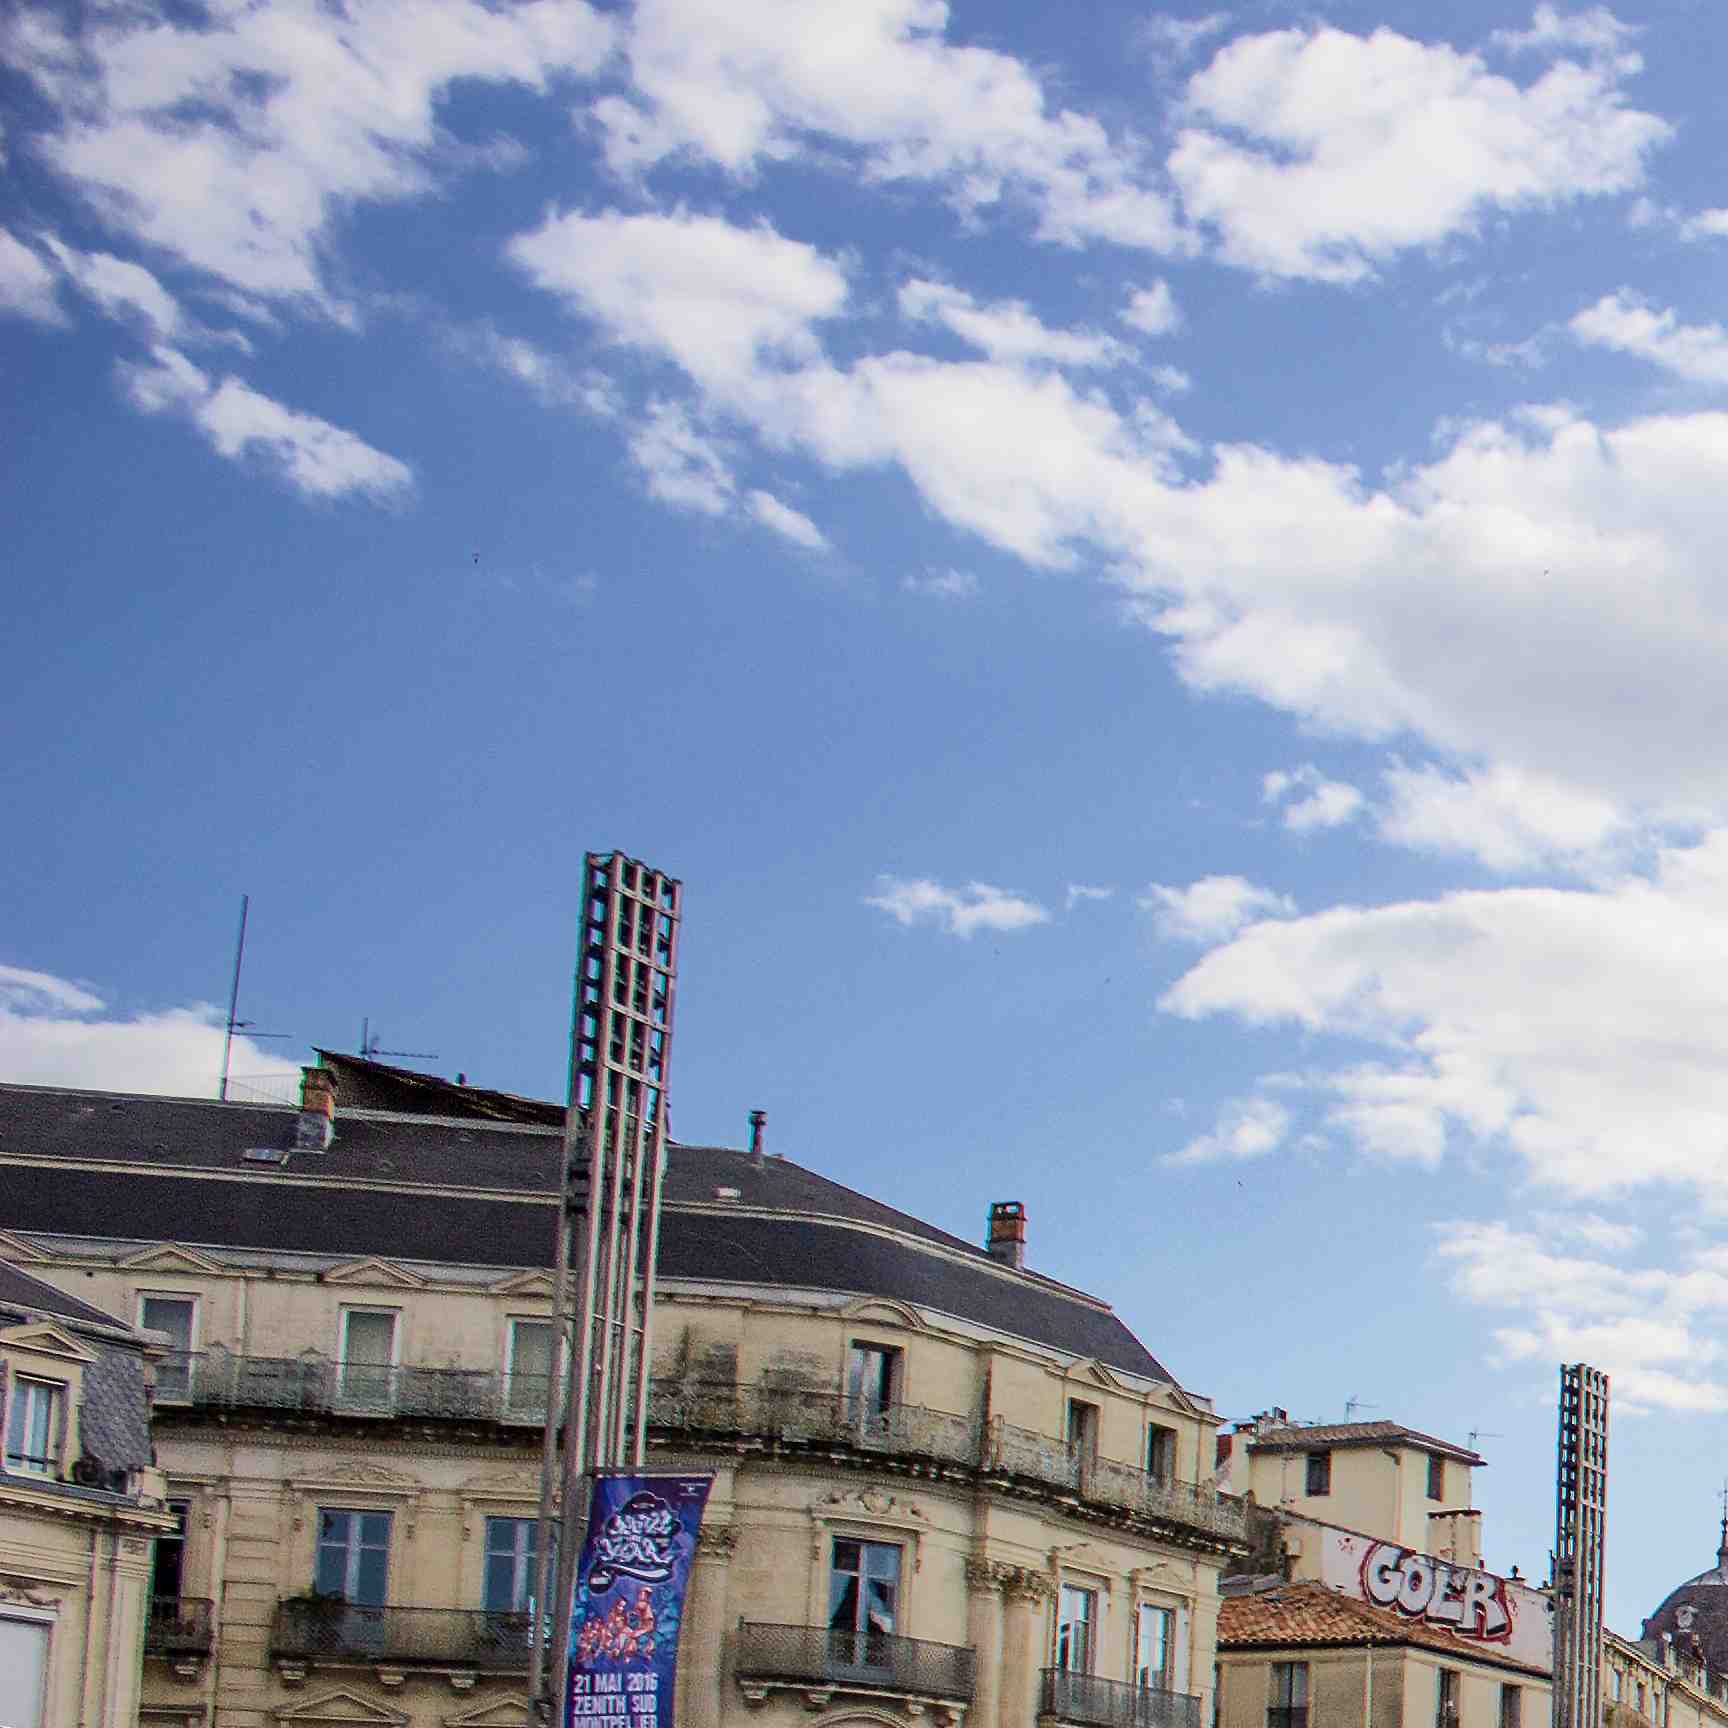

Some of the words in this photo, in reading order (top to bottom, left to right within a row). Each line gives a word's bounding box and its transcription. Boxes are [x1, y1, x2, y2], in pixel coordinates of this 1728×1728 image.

[573, 1674, 592, 1693] 21
[594, 1673, 623, 1693] MAI
[627, 1672, 659, 1692] 2016
[573, 1694, 627, 1715] ZENITH
[631, 1693, 657, 1713] SUD
